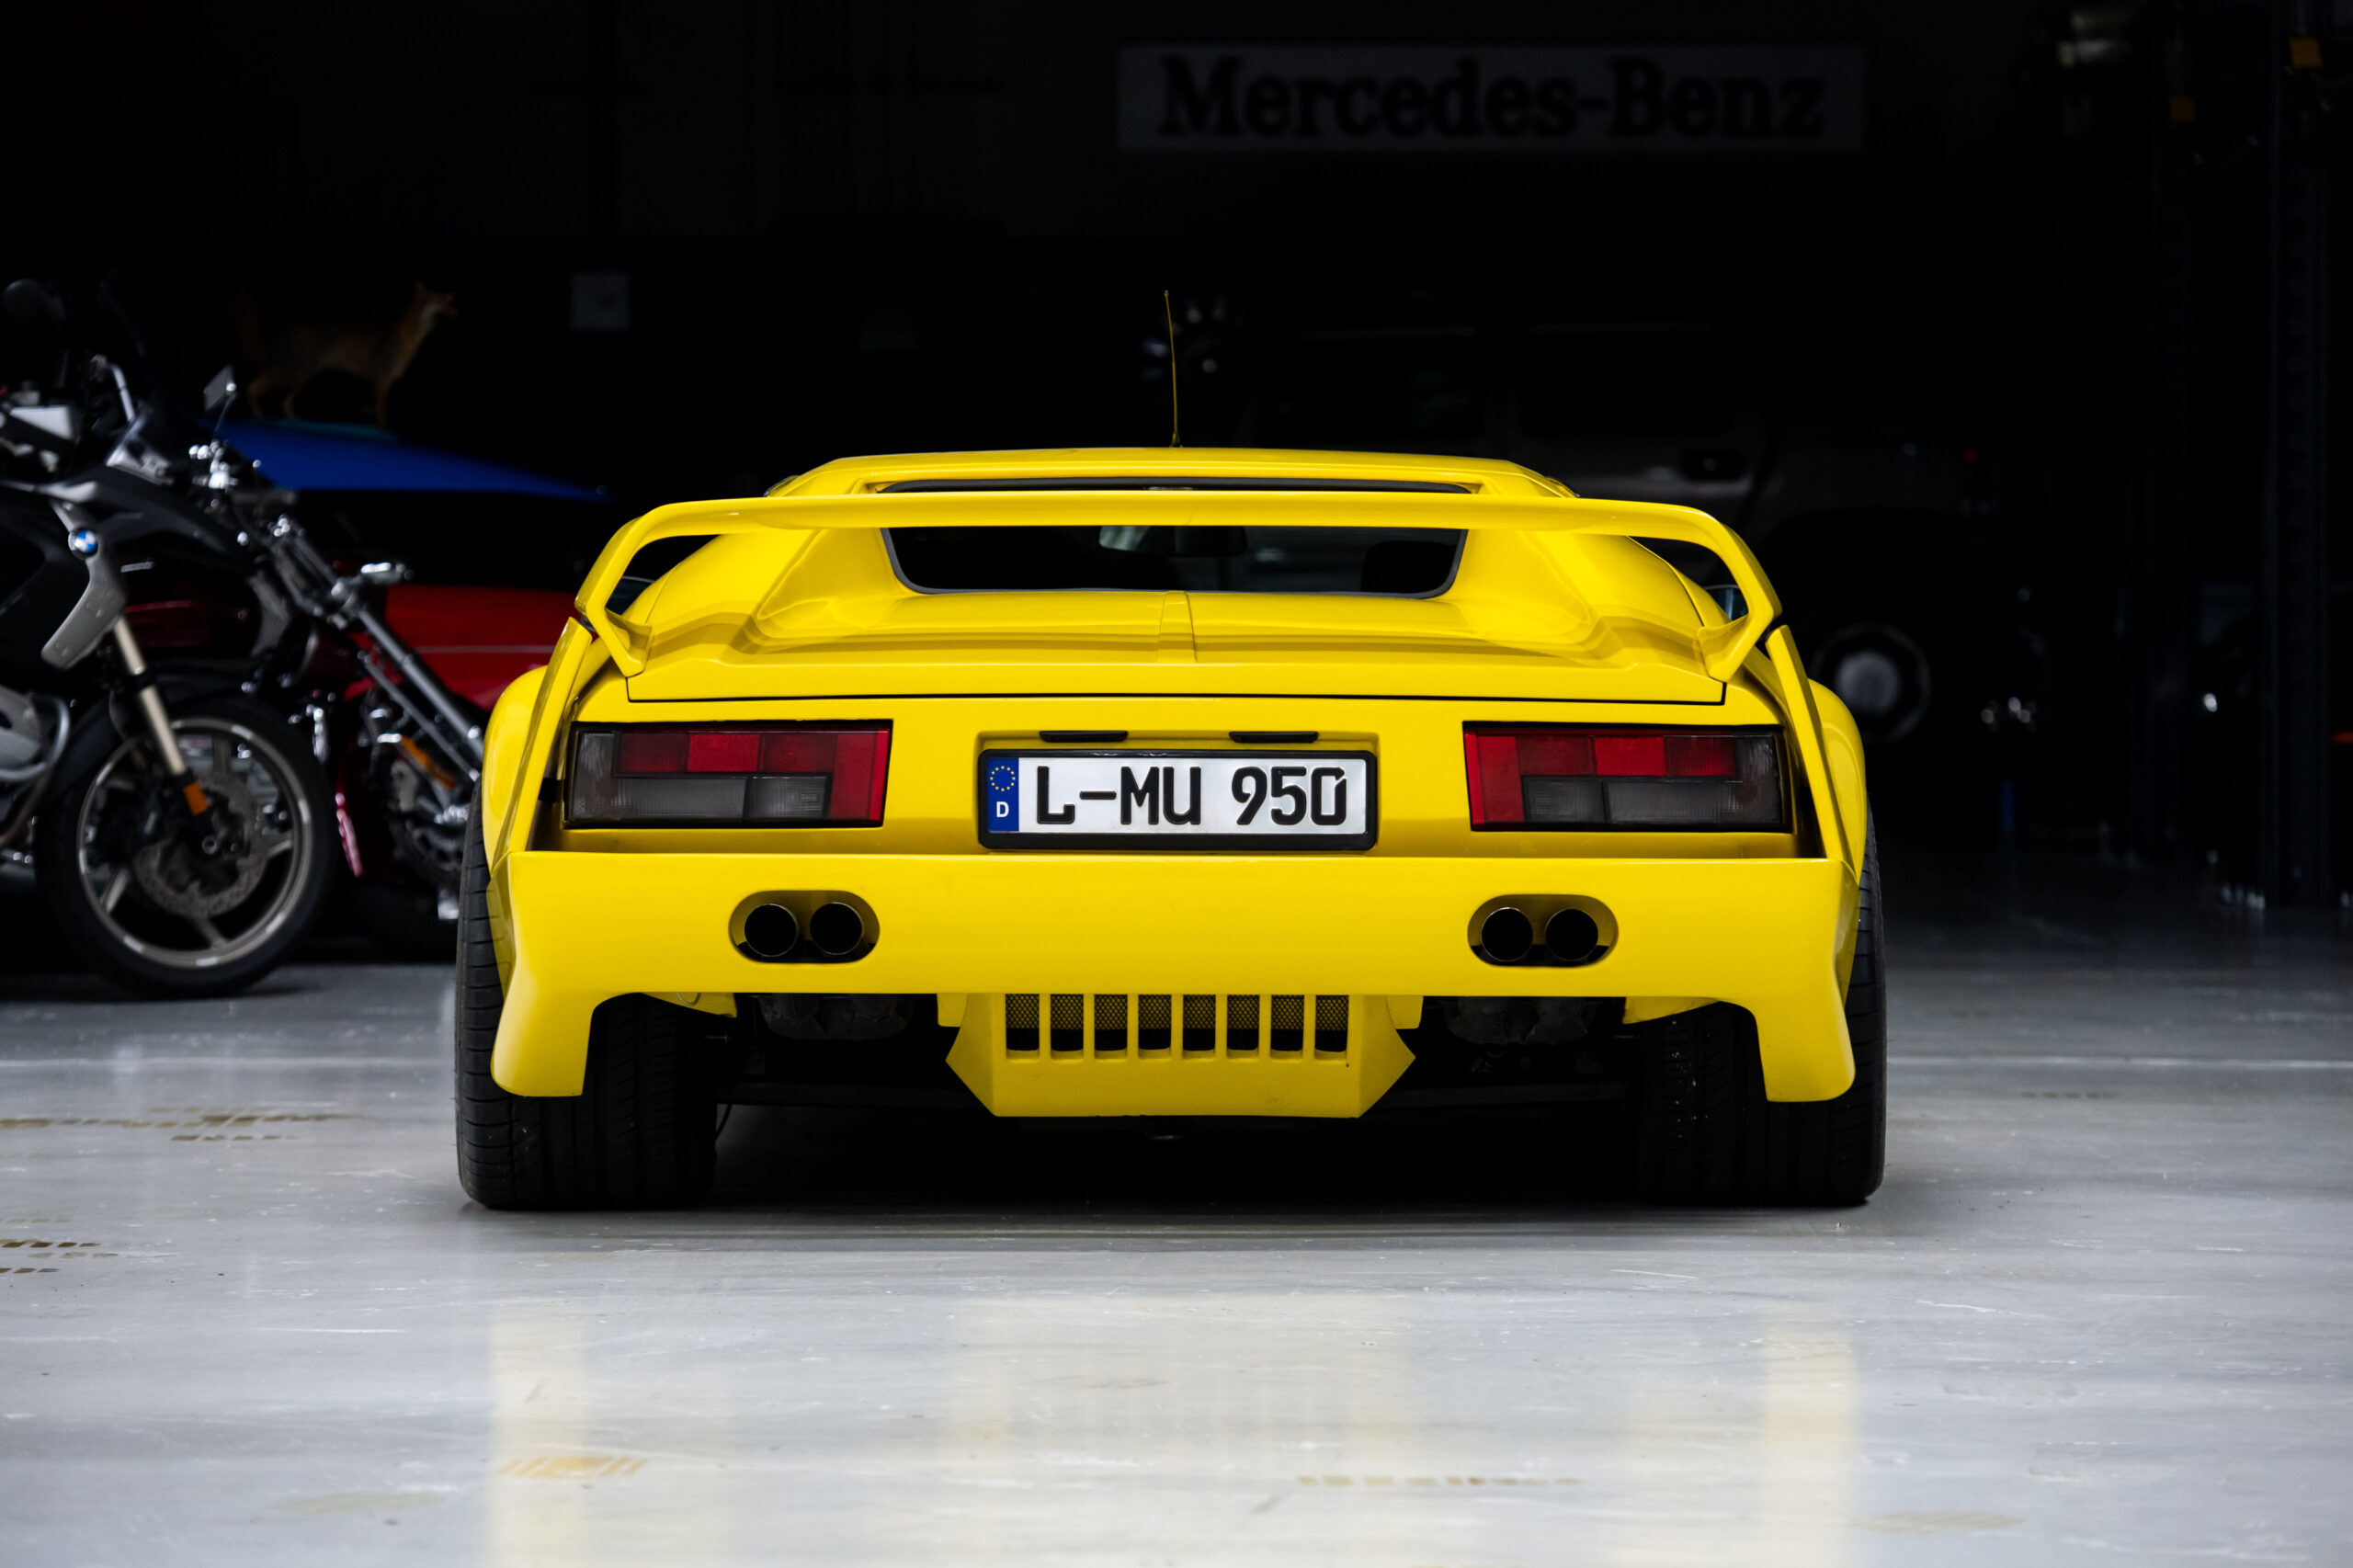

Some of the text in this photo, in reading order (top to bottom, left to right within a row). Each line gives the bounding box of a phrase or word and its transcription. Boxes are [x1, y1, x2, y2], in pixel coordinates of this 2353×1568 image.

[1159, 58, 1825, 137] Mercedes-Benz
[995, 801, 1009, 818] D
[1231, 767, 1347, 825] 950
